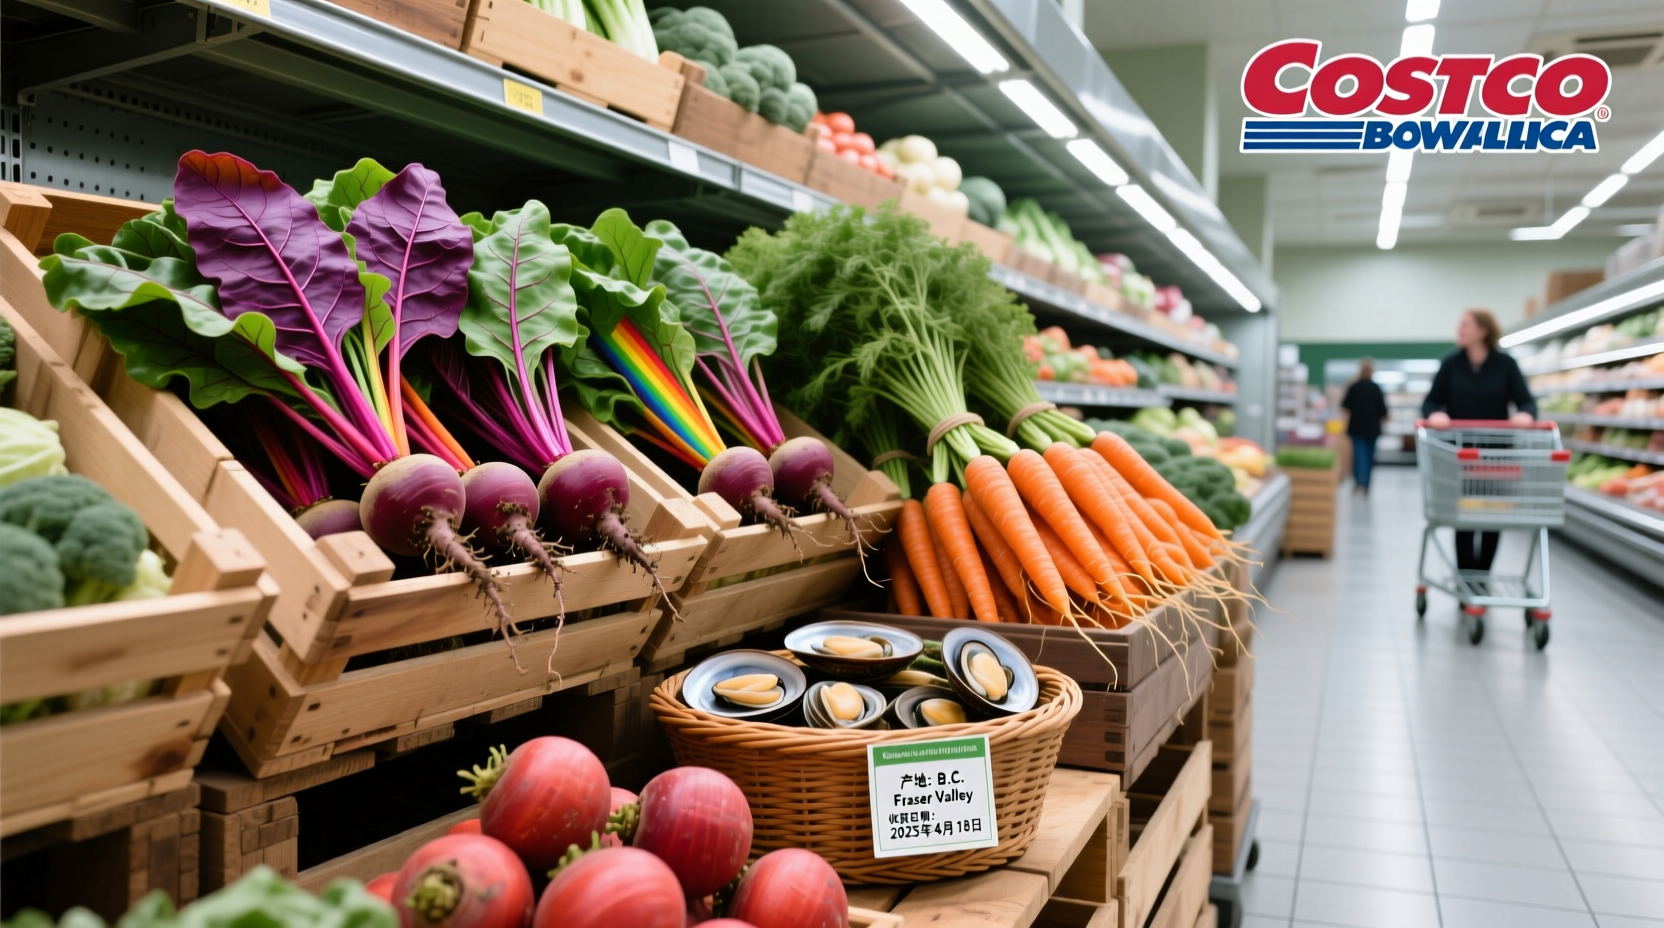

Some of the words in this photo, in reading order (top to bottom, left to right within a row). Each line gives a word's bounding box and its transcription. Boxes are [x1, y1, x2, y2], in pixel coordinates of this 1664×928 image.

[937, 770, 965, 786] B.C.
[893, 793, 933, 807] Fraser
[934, 788, 974, 804] Valley
